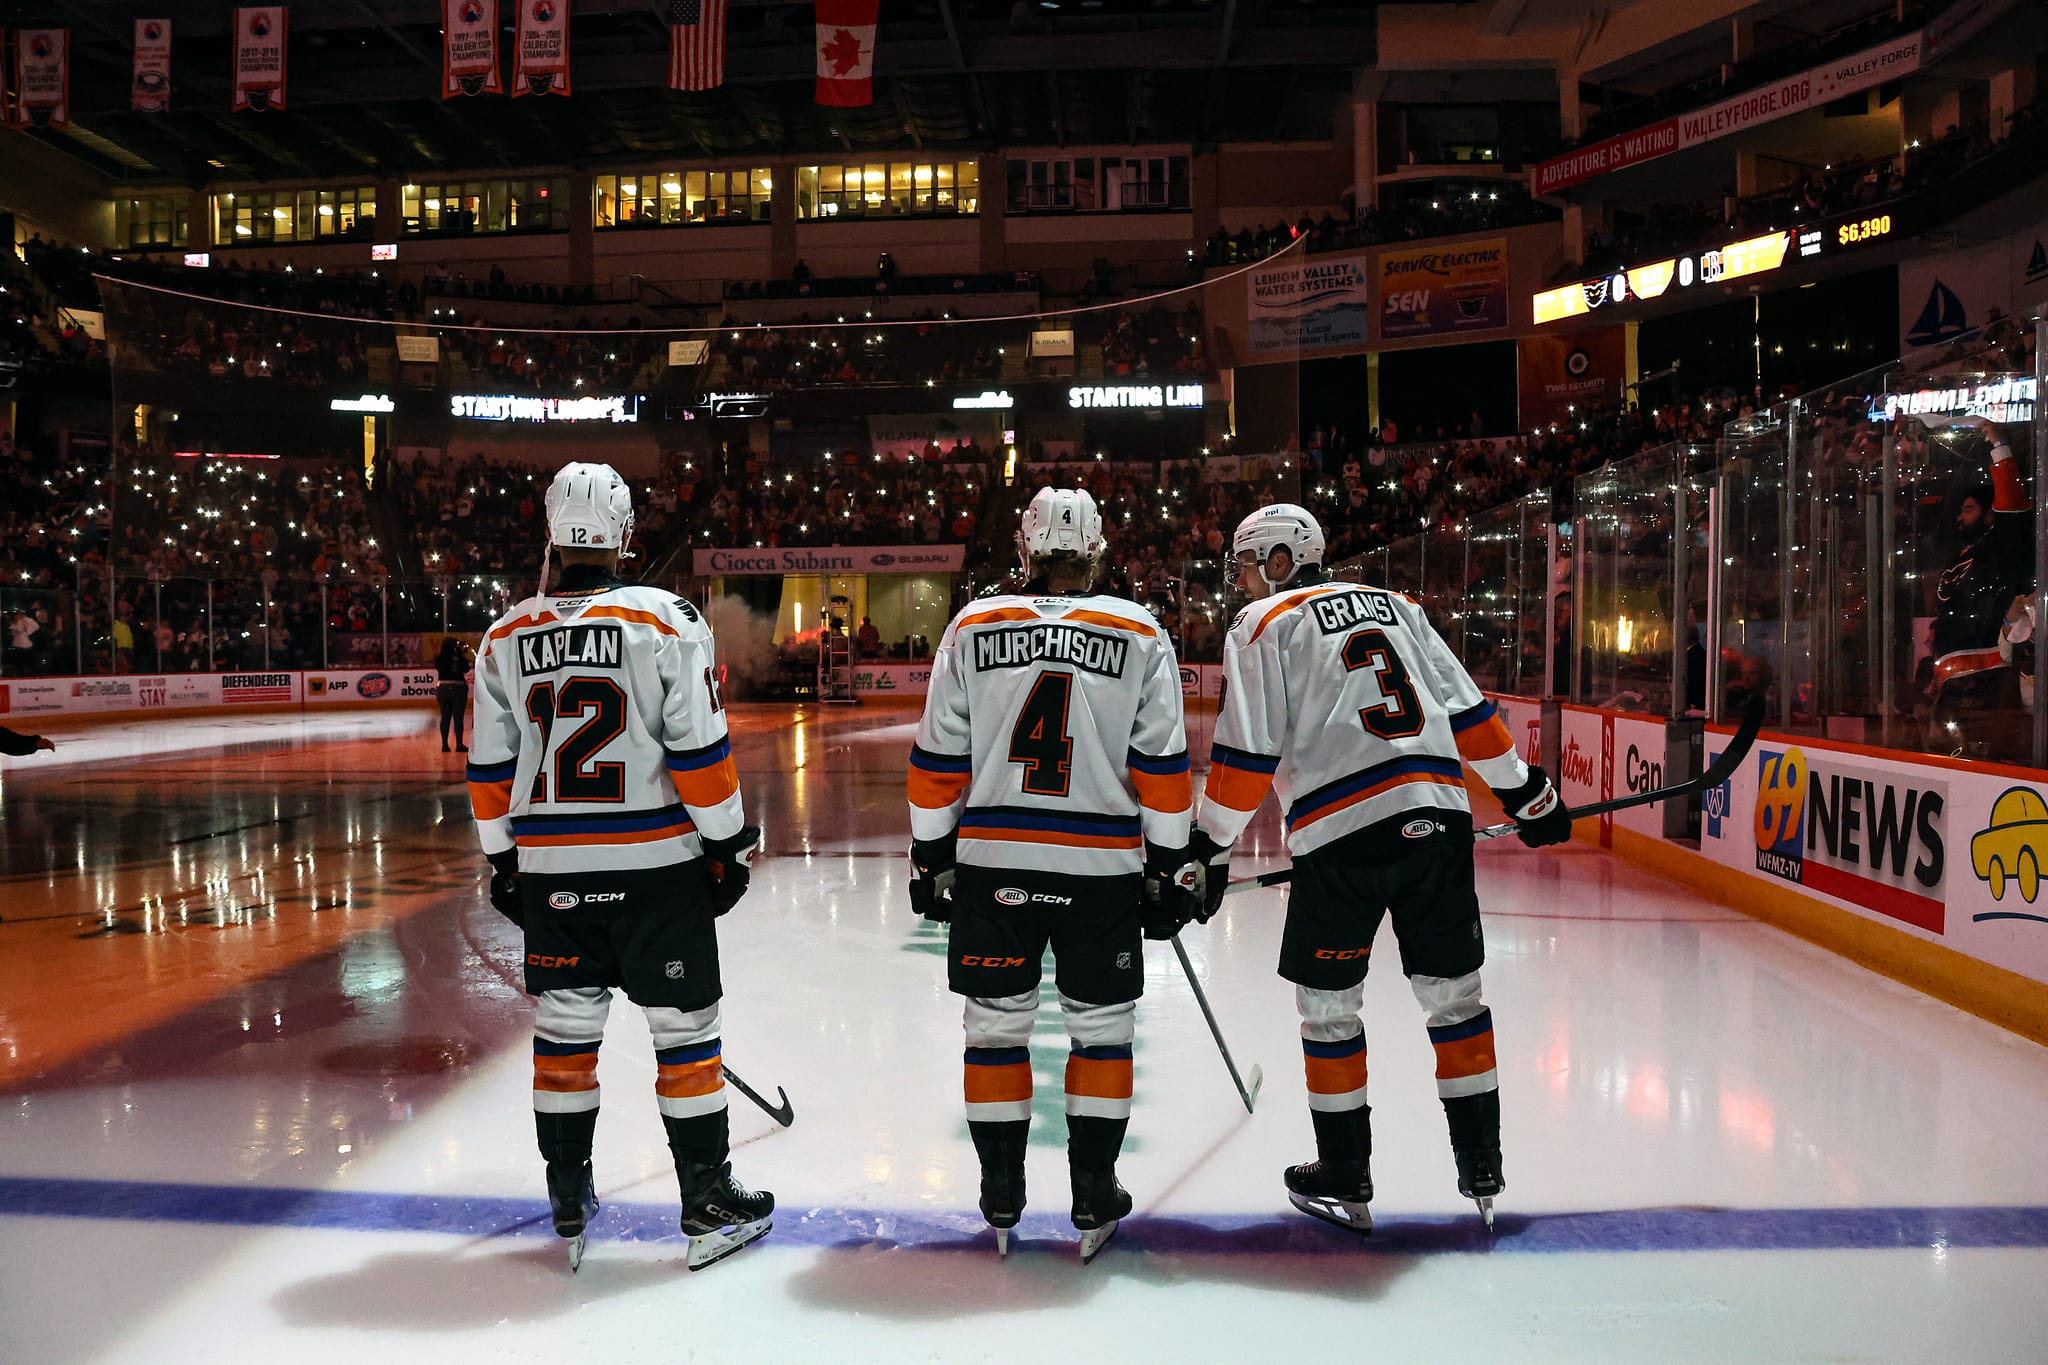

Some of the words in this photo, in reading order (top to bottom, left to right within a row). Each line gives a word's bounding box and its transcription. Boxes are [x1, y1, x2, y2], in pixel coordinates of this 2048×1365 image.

[452, 41, 477, 51] CALDER
[479, 40, 491, 49] CUP
[523, 40, 548, 49] CALDER
[549, 39, 561, 48] CUP
[453, 50, 491, 61] CHAMPIONS
[523, 50, 560, 58] CHAMPIONS
[1836, 58, 1878, 81] VALLEY
[1881, 44, 1919, 66] FORGE
[1684, 80, 1809, 141] VALLEYFORGE.ORG
[1541, 151, 1606, 186] ADVENTURE
[1609, 143, 1621, 165] IS
[1624, 128, 1675, 158] WAITING
[1838, 215, 1890, 245] $6,390
[1442, 249, 1500, 268] ELECTRIC
[1255, 270, 1300, 286] LEHIGH
[1303, 264, 1349, 280] VALLEY
[1613, 275, 1625, 302] 0
[1680, 258, 1693, 286] 0
[1255, 283, 1296, 298] WATER
[1299, 275, 1354, 293] SYSTEMS
[1385, 289, 1431, 315] SEN
[1306, 323, 1332, 334] Local
[1255, 338, 1281, 351] Water
[1323, 331, 1361, 345] Experts
[1068, 387, 1163, 408] STARTING
[1062, 509, 1071, 524] 4
[1265, 508, 1279, 517] ppl
[571, 527, 587, 544] 12
[710, 552, 776, 572] Ciocca
[782, 551, 853, 571] Subaru
[898, 554, 950, 564] SUBARU
[1317, 592, 1393, 631] GRANS
[522, 629, 618, 672] KAPLAN
[978, 627, 1124, 675] MURCHISON
[222, 674, 292, 688] DIEFENDERFER
[328, 681, 348, 691] APP
[402, 675, 410, 684] a
[413, 673, 434, 684] sub
[856, 673, 873, 681] AIR
[1340, 628, 1425, 741] 3
[139, 689, 167, 707] STAY
[401, 686, 437, 697] above
[525, 676, 627, 805] 12
[1008, 670, 1073, 798] 4
[1754, 746, 1807, 851] 69
[1410, 823, 1428, 834] AHL
[1807, 770, 1945, 887] NEWS
[555, 895, 573, 905] AHL
[584, 892, 626, 904] CCM
[1003, 891, 1022, 901] AHL
[1031, 893, 1073, 906] CCM
[527, 953, 580, 969] CCM
[960, 953, 1026, 969] CCM
[705, 1203, 747, 1225] CCM
